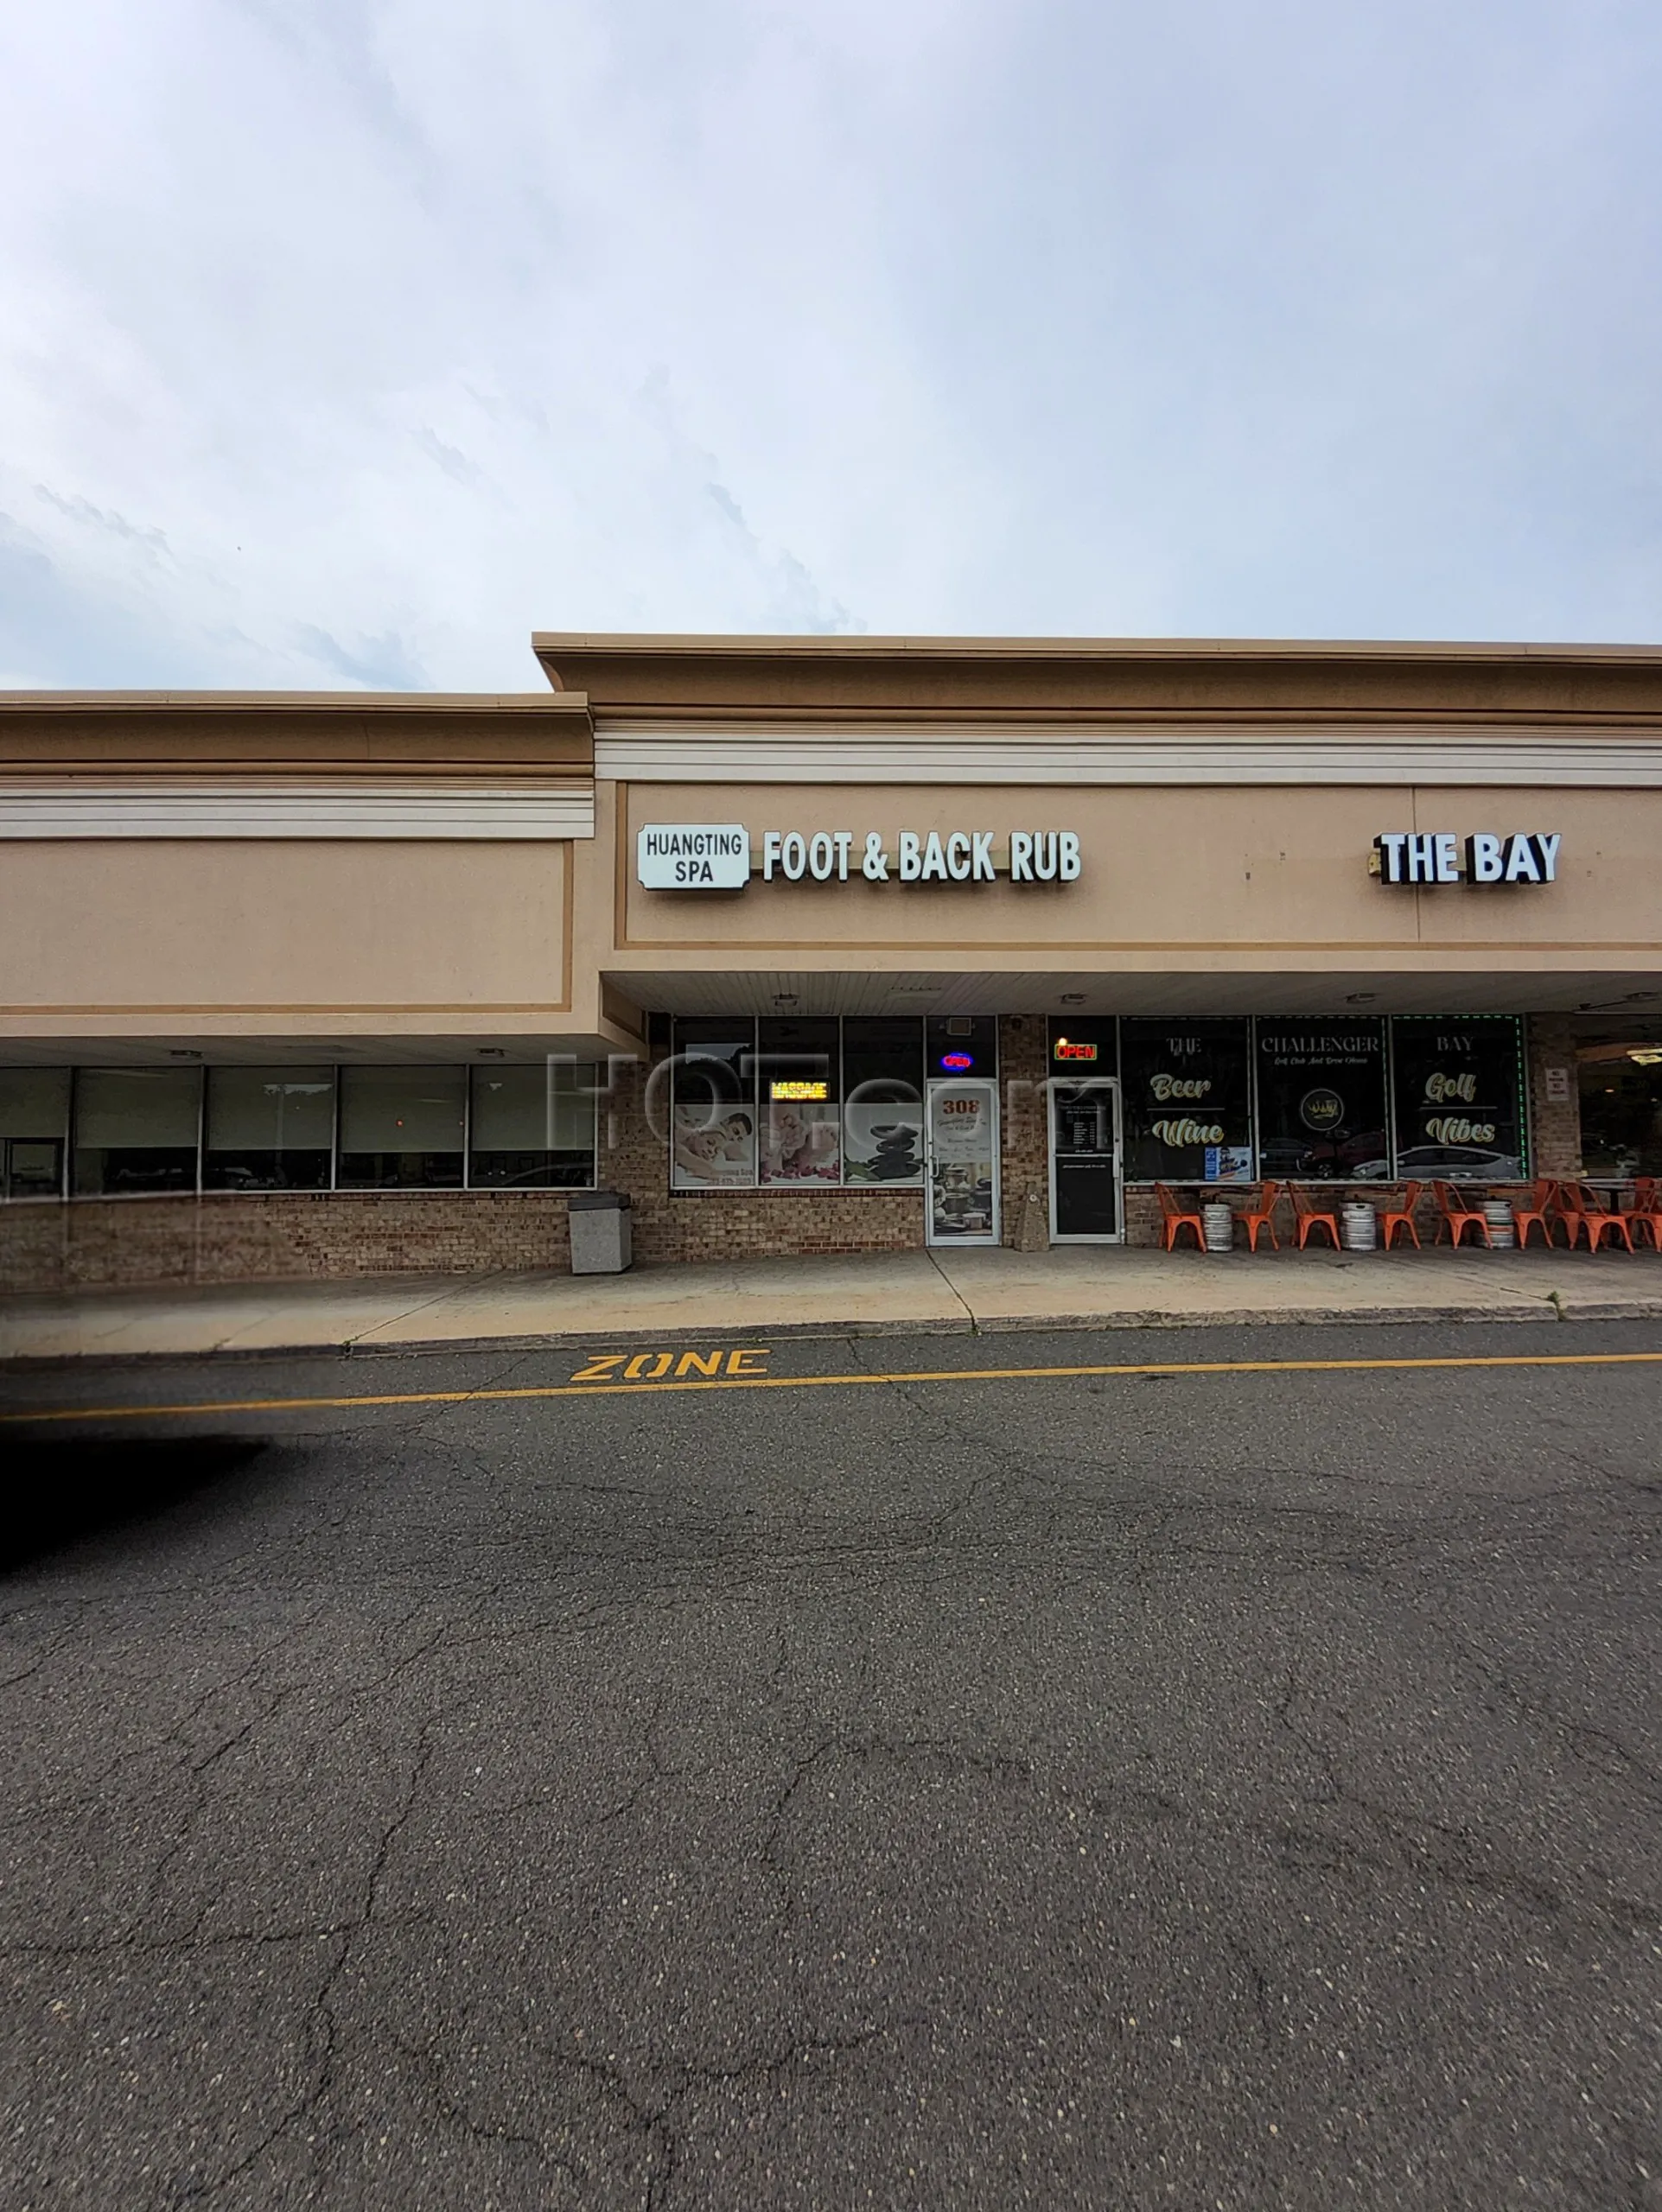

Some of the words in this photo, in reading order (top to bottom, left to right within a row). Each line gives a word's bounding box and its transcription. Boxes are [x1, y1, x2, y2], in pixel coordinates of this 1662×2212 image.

[646, 834, 742, 855] HUANGTING
[763, 831, 852, 881] FOOT
[863, 831, 889, 881] &
[899, 831, 996, 881] BACK
[1010, 831, 1080, 881] RUB
[1380, 834, 1459, 882] THE
[1473, 834, 1562, 882] BAY
[675, 861, 714, 882] SPA
[1057, 1046, 1095, 1058] OPEN
[1262, 1036, 1379, 1052] CHALLENGER
[1436, 1036, 1473, 1052] BAY
[1150, 1073, 1212, 1102] Beer
[1425, 1072, 1476, 1103] Golf
[942, 1099, 981, 1114] 308
[1151, 1118, 1225, 1147] Wine
[1426, 1116, 1495, 1145] Vibes
[570, 1349, 770, 1381] ZONE
